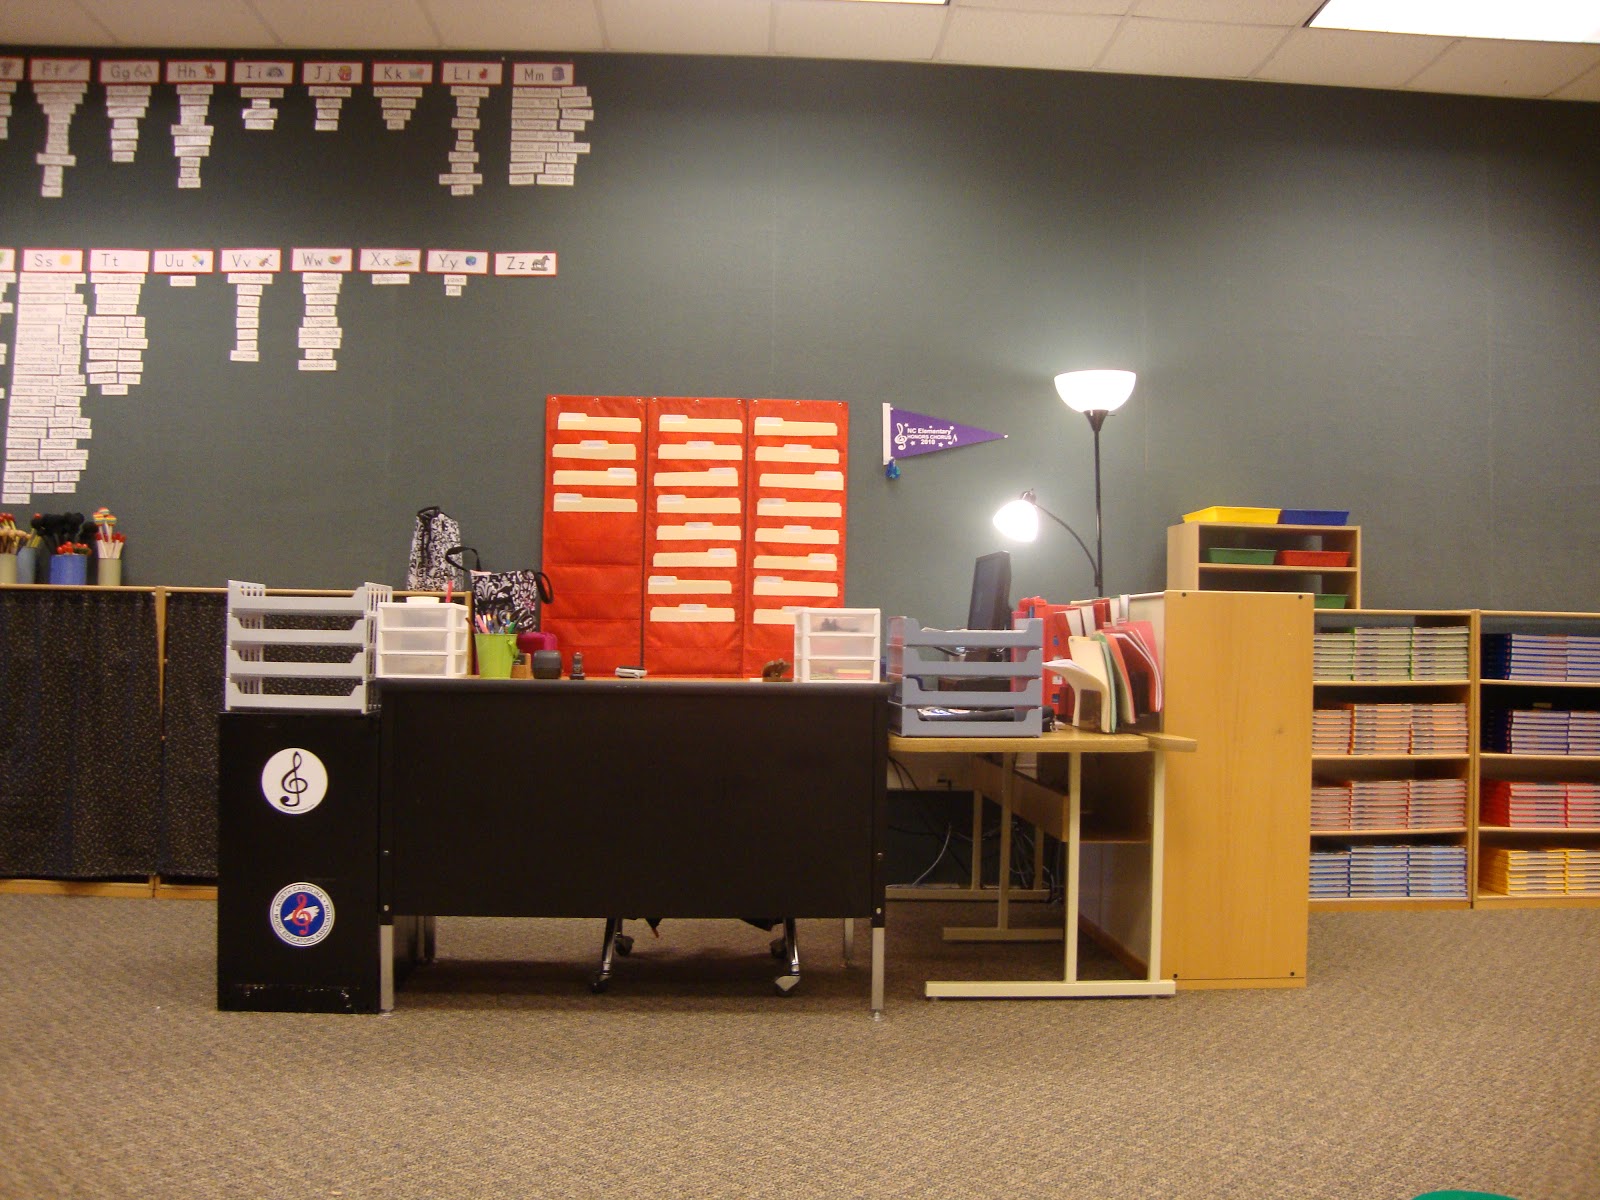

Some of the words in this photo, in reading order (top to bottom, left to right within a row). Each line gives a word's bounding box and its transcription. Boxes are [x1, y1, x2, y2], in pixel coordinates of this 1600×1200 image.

[110, 63, 130, 80] Gg
[177, 64, 196, 79] Hh
[384, 66, 402, 80] Kk
[524, 67, 545, 81] Mm
[34, 254, 52, 267] Ss
[101, 253, 118, 267] Tt
[165, 254, 183, 267] Uu
[232, 254, 251, 267] Vv
[303, 253, 323, 267] Ww
[370, 252, 390, 266] Xx
[439, 254, 457, 270] Yy
[507, 256, 525, 269] Zz
[276, 890, 293, 907] NORTH
[293, 886, 323, 900] CAROLINA
[282, 931, 315, 943] EDUCATORS
